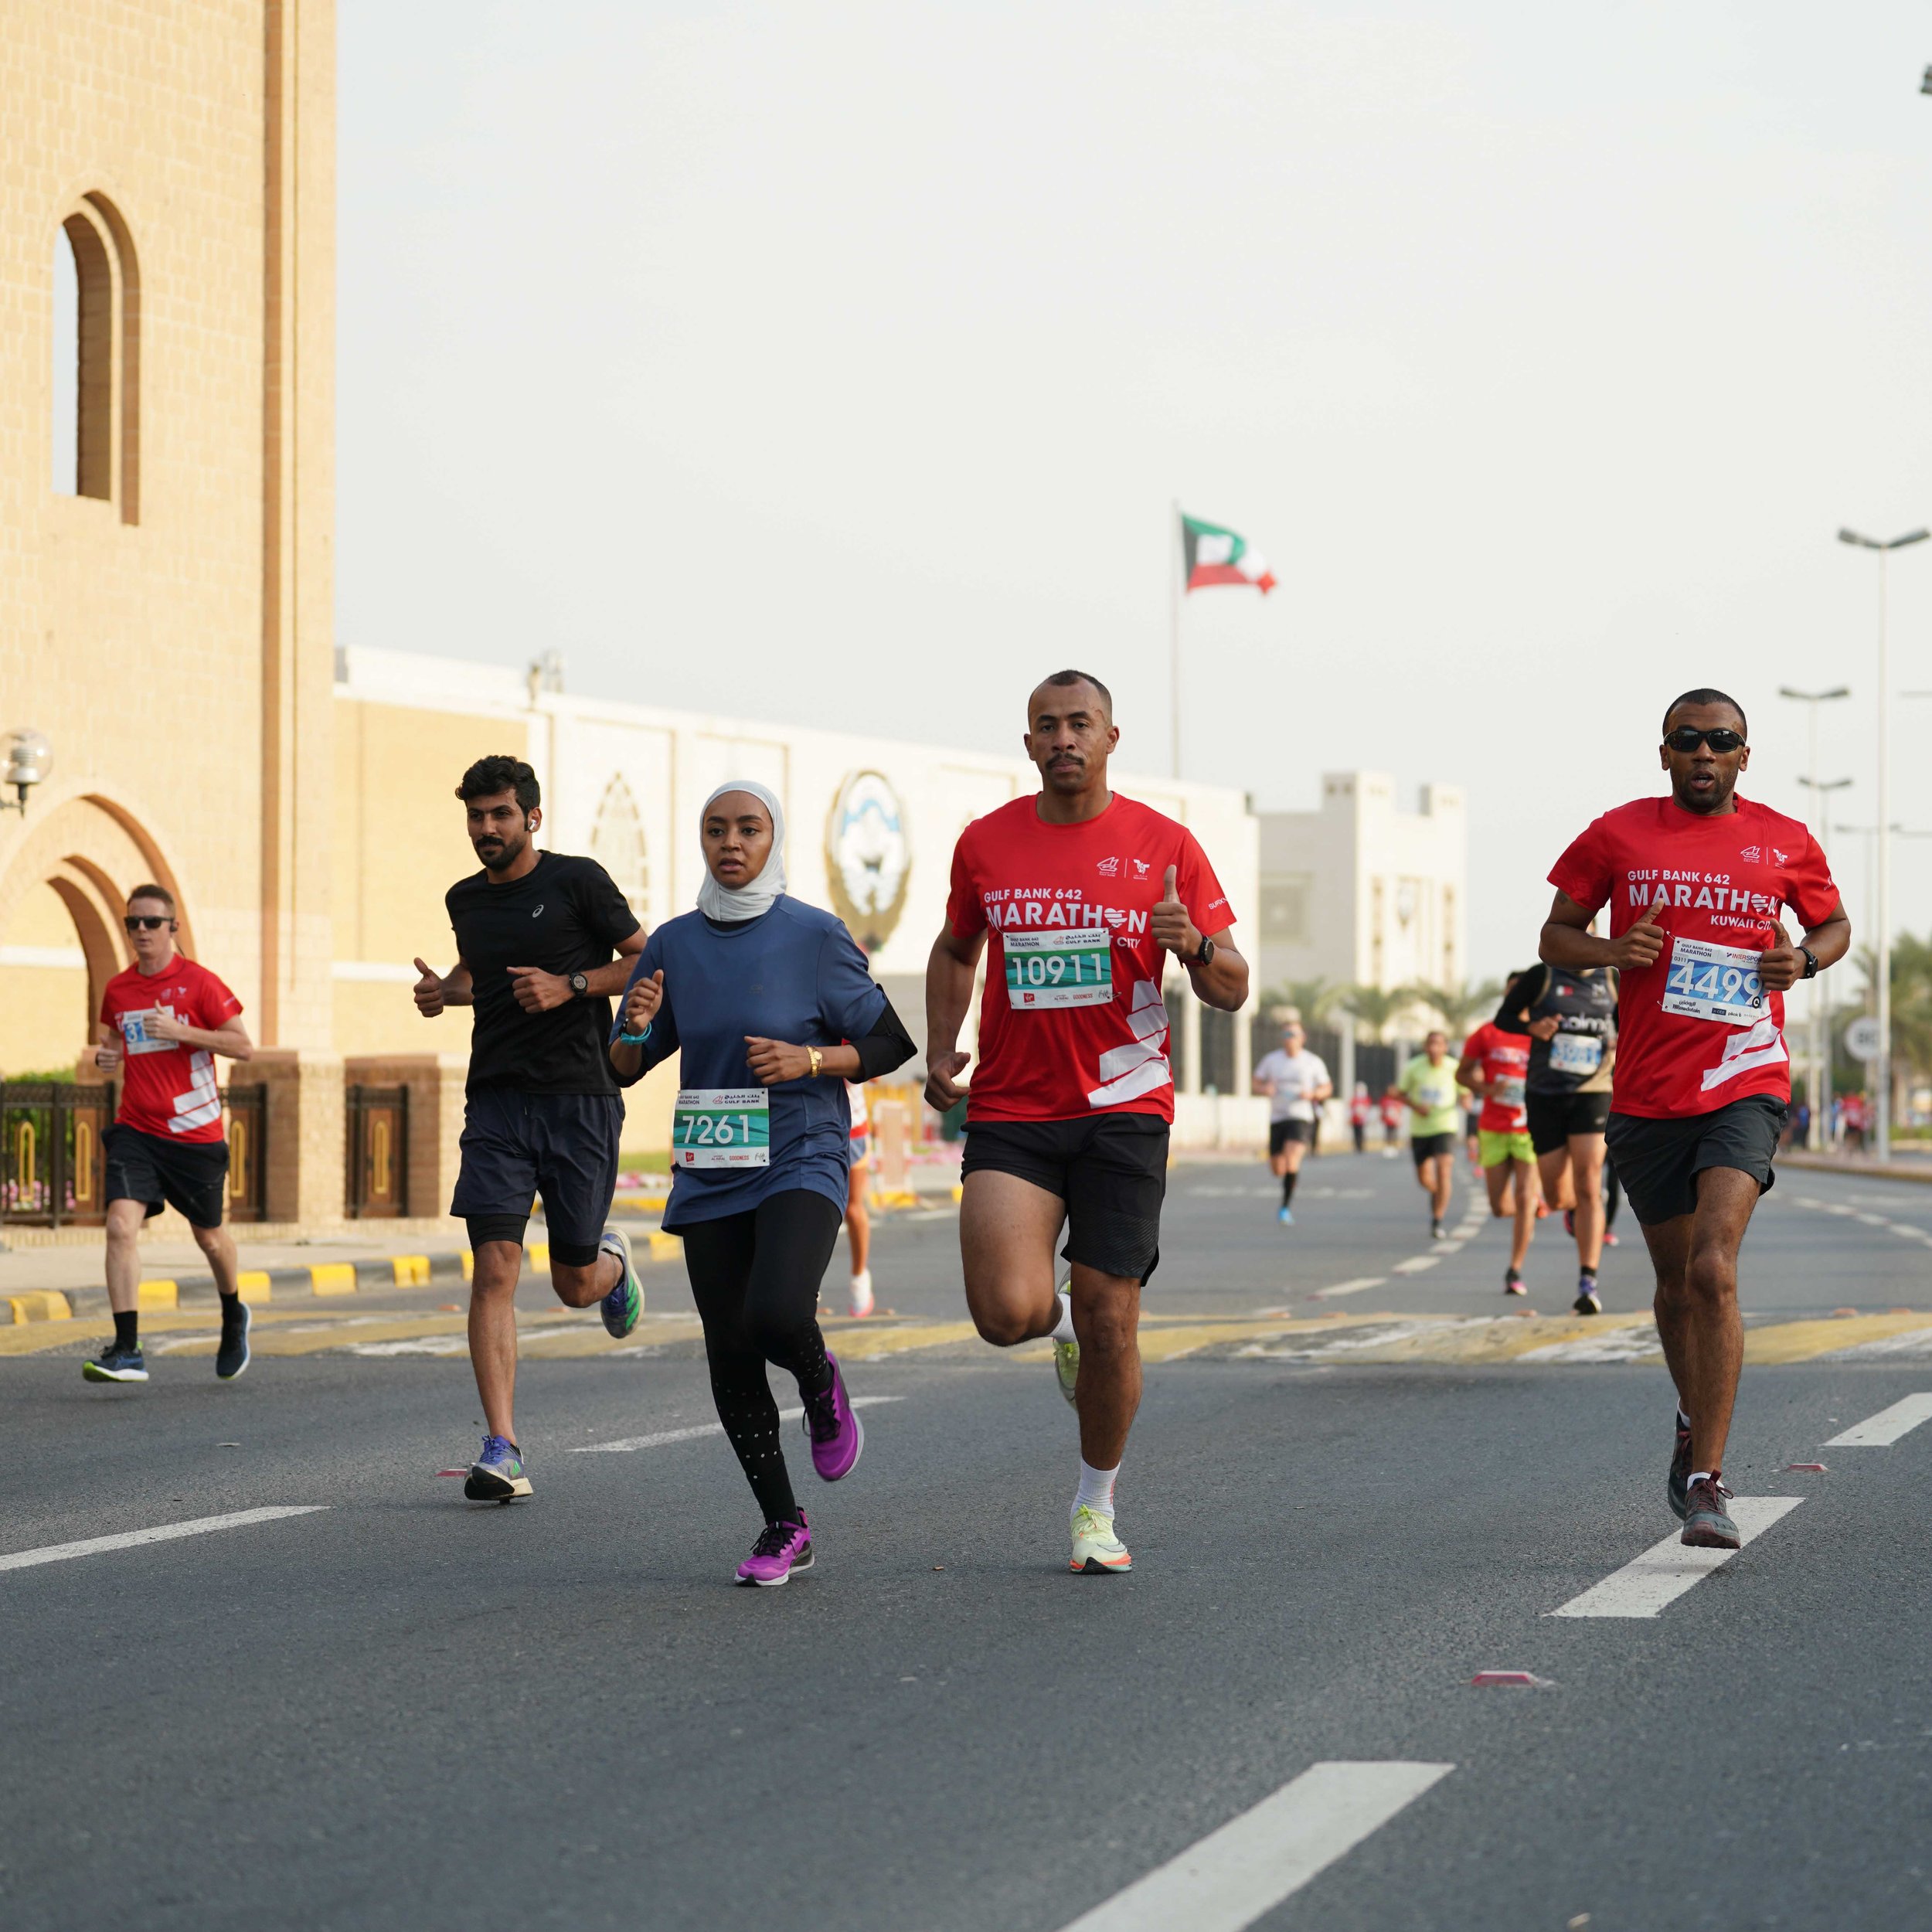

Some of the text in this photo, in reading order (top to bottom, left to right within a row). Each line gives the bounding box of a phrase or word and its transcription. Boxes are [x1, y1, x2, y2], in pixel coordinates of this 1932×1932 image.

[1627, 869, 1730, 885] GULF BANK 642
[984, 888, 1082, 903] GULF BANK 642
[1710, 915, 1755, 930] KUWAIT
[1117, 937, 1141, 949] CITY
[1680, 947, 1712, 957] MARATHON
[1012, 953, 1102, 985] 10911
[1669, 961, 1762, 1005] 4499
[682, 1114, 749, 1145] 7261
